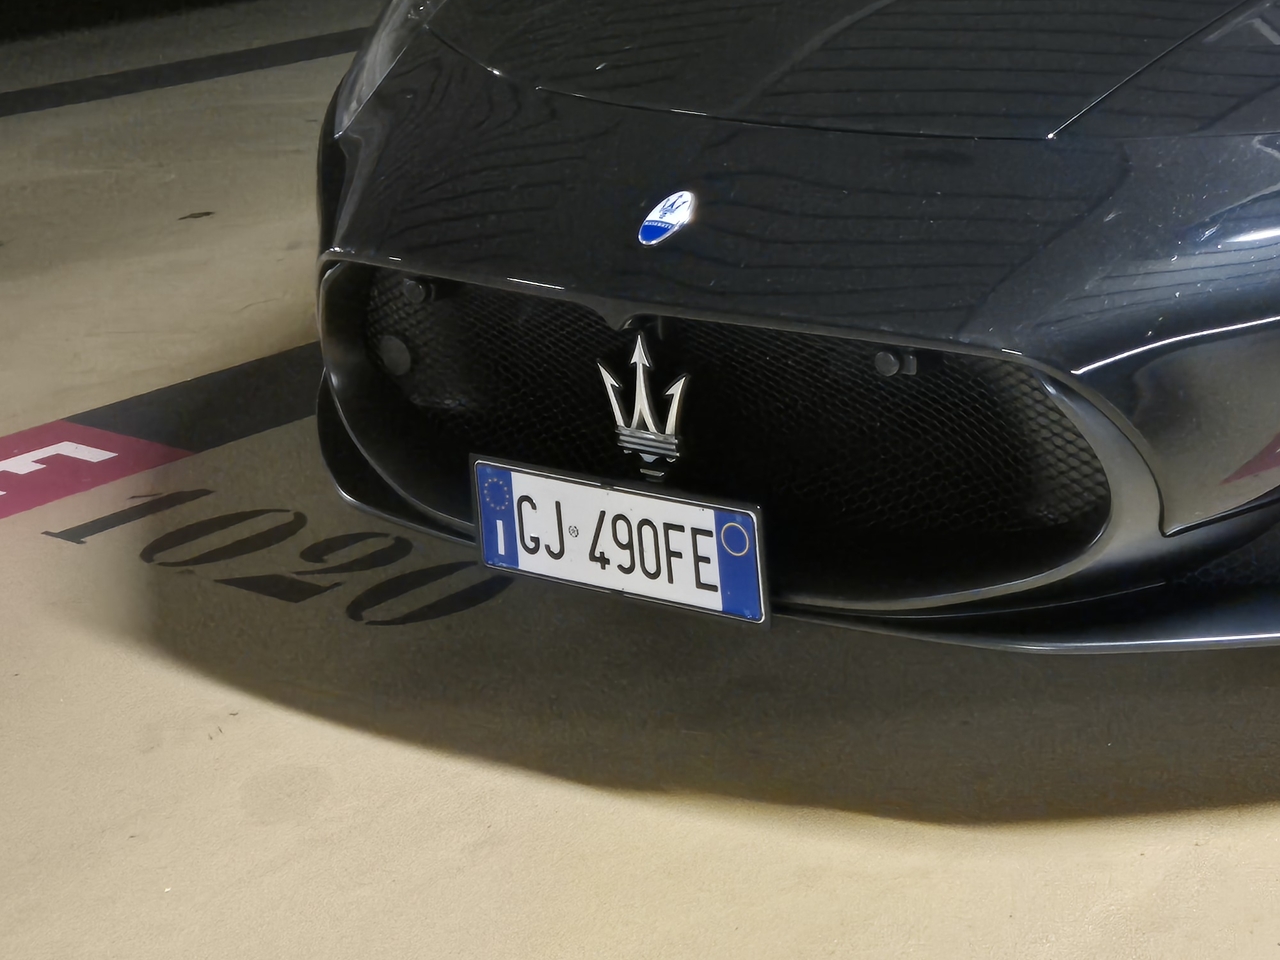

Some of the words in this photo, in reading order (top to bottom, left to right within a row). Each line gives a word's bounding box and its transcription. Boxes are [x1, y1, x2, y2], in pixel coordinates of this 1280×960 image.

[41, 489, 516, 627] 1020
[516, 494, 565, 561] GJ
[588, 509, 719, 593] 490FE
